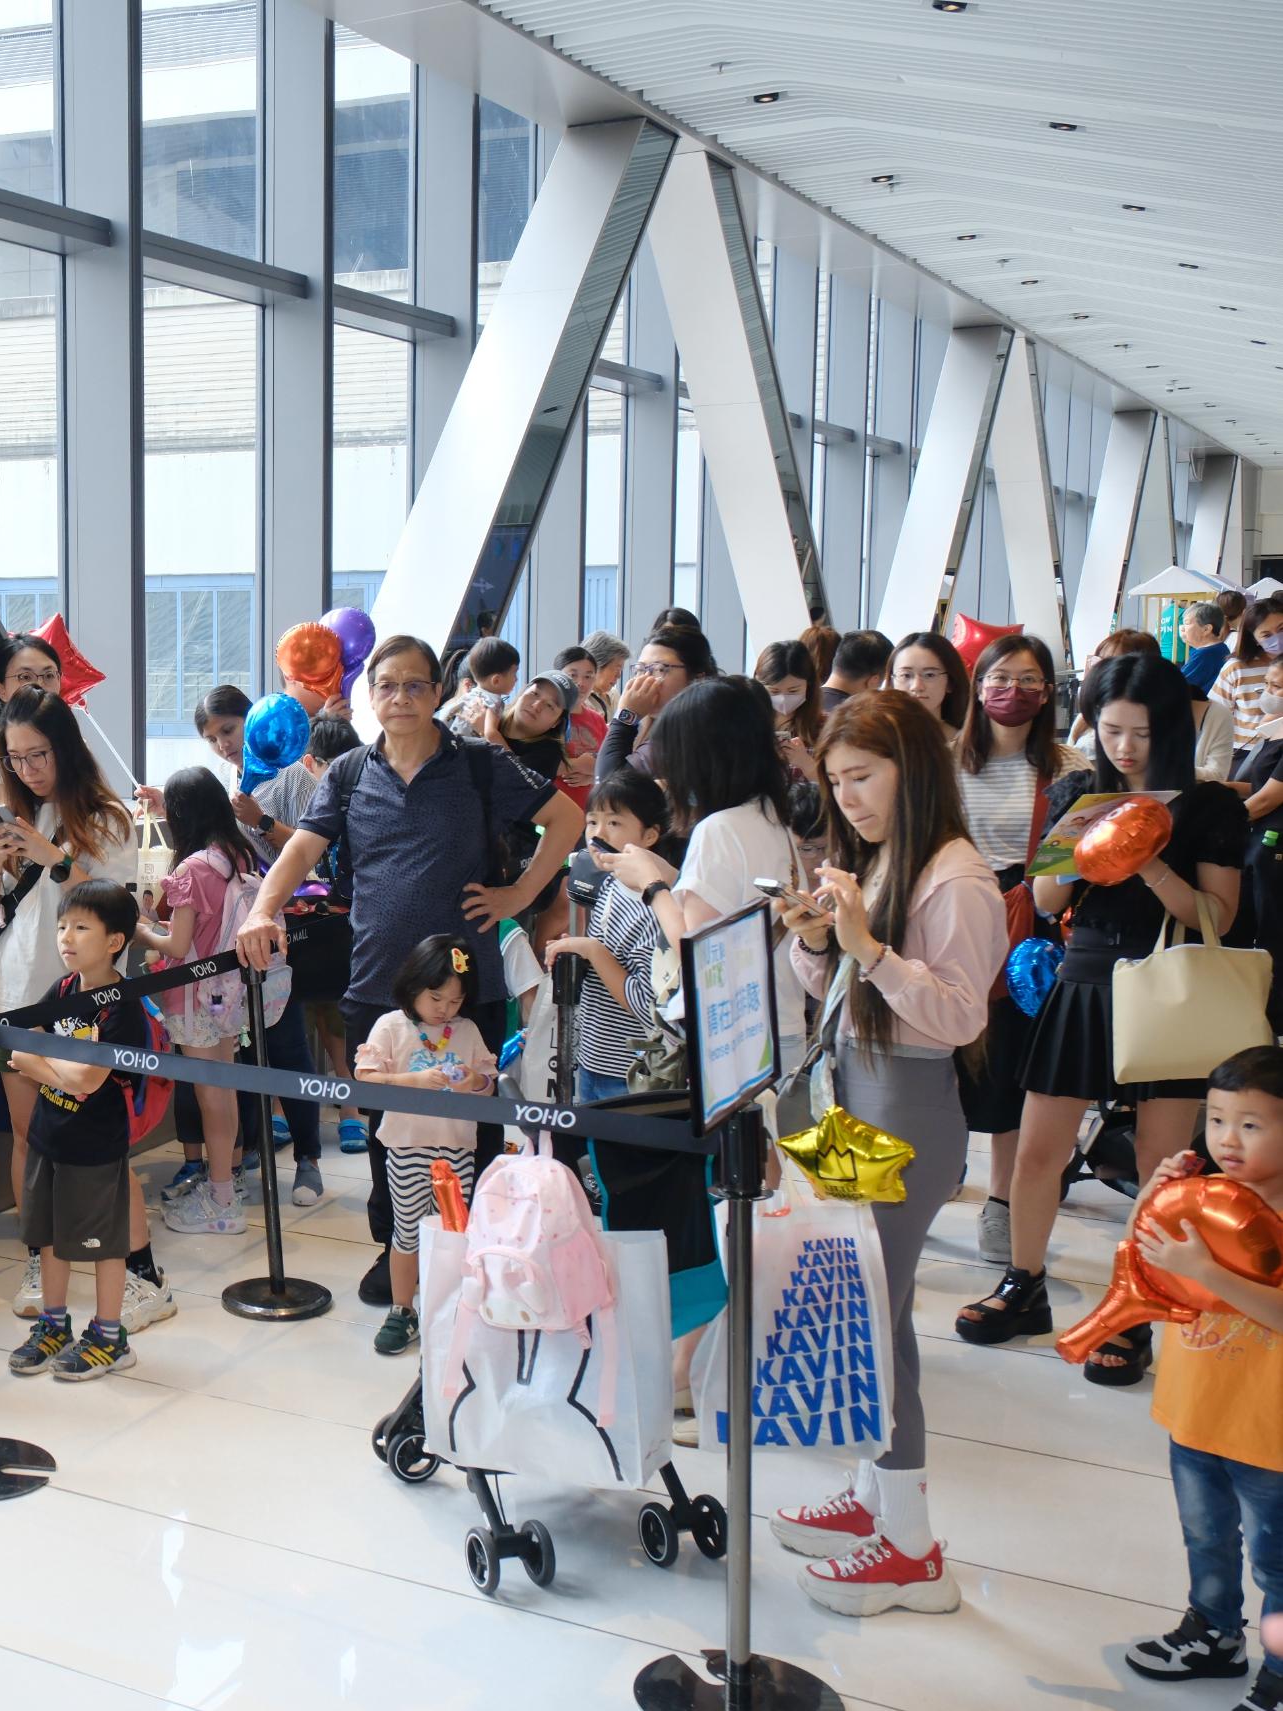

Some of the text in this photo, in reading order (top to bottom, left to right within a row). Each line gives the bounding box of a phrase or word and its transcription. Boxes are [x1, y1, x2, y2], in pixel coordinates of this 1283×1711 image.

[189, 961, 217, 979] YOHO
[91, 988, 122, 1006] YOHO
[113, 1049, 160, 1071] YOHO
[298, 1077, 351, 1100] YOHO
[514, 1104, 577, 1129] YOHO
[803, 1237, 856, 1253] KAVIN
[797, 1250, 858, 1269] KAVIN
[790, 1264, 862, 1287] KAVIN
[782, 1281, 866, 1307] KAVIN
[774, 1301, 869, 1331] KAVIN
[766, 1320, 872, 1358] KAVIN
[757, 1344, 875, 1386] KAVIN
